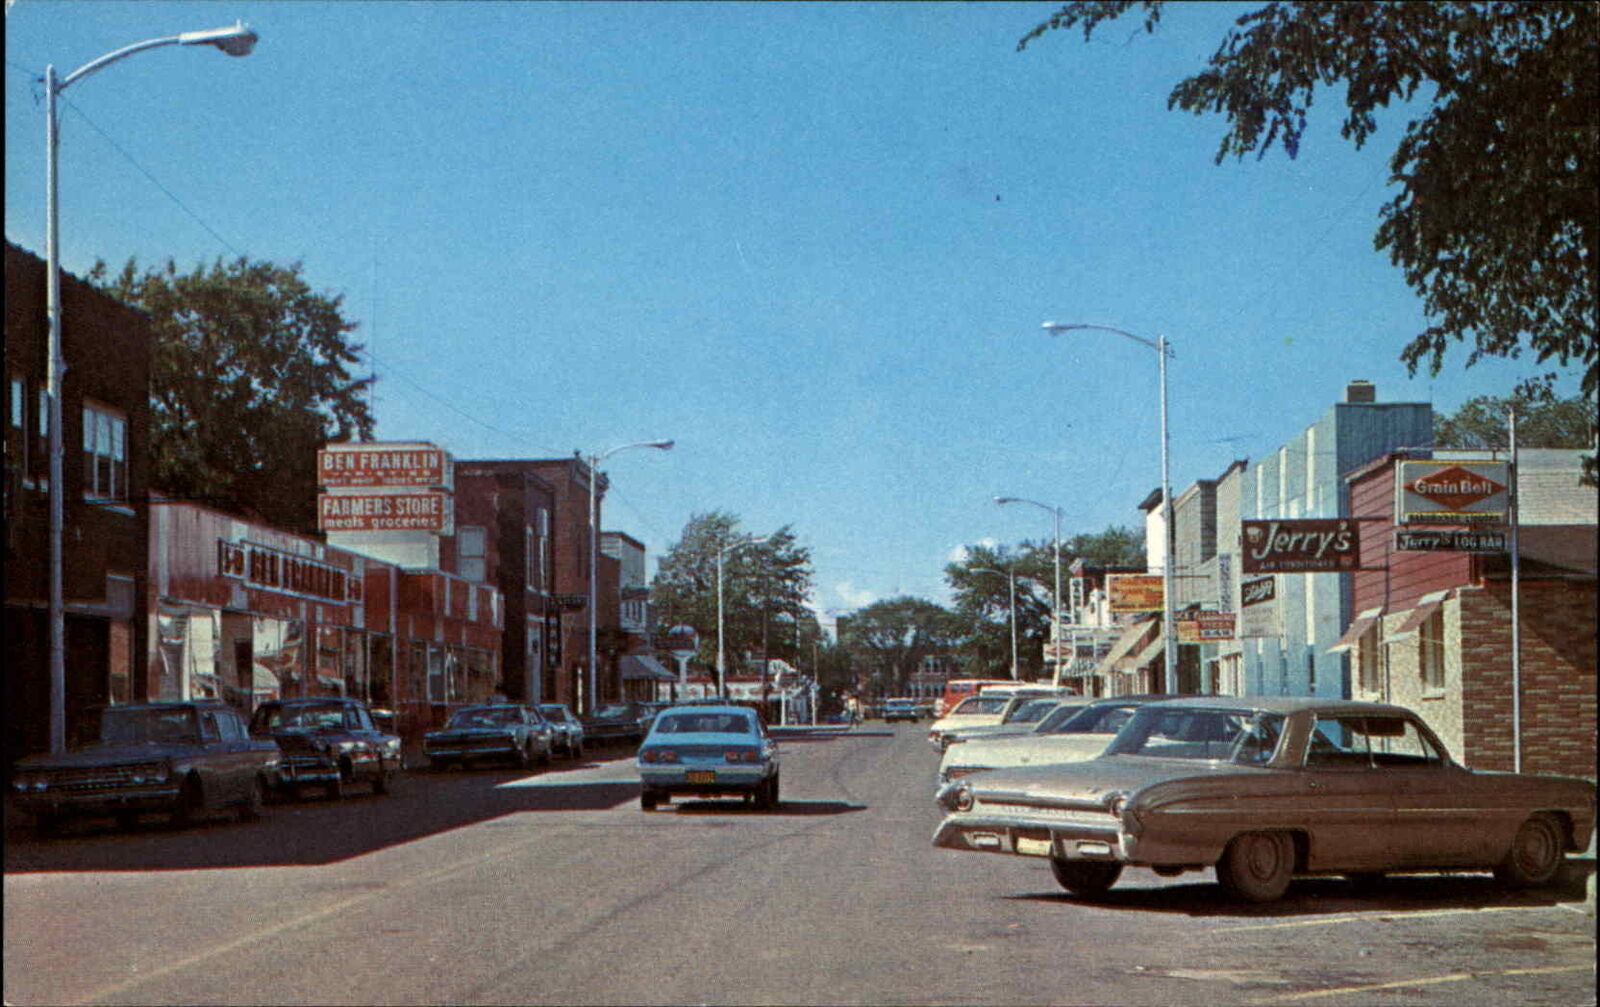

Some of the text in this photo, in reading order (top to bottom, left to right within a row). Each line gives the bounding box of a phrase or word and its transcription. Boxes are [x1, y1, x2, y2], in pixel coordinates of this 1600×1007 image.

[323, 452, 439, 471] BEN FRANKLIN
[1414, 478, 1458, 494] Grain
[323, 497, 439, 516] FARMERS STORE
[370, 516, 438, 530] groceries
[1251, 520, 1352, 559] Jerry's
